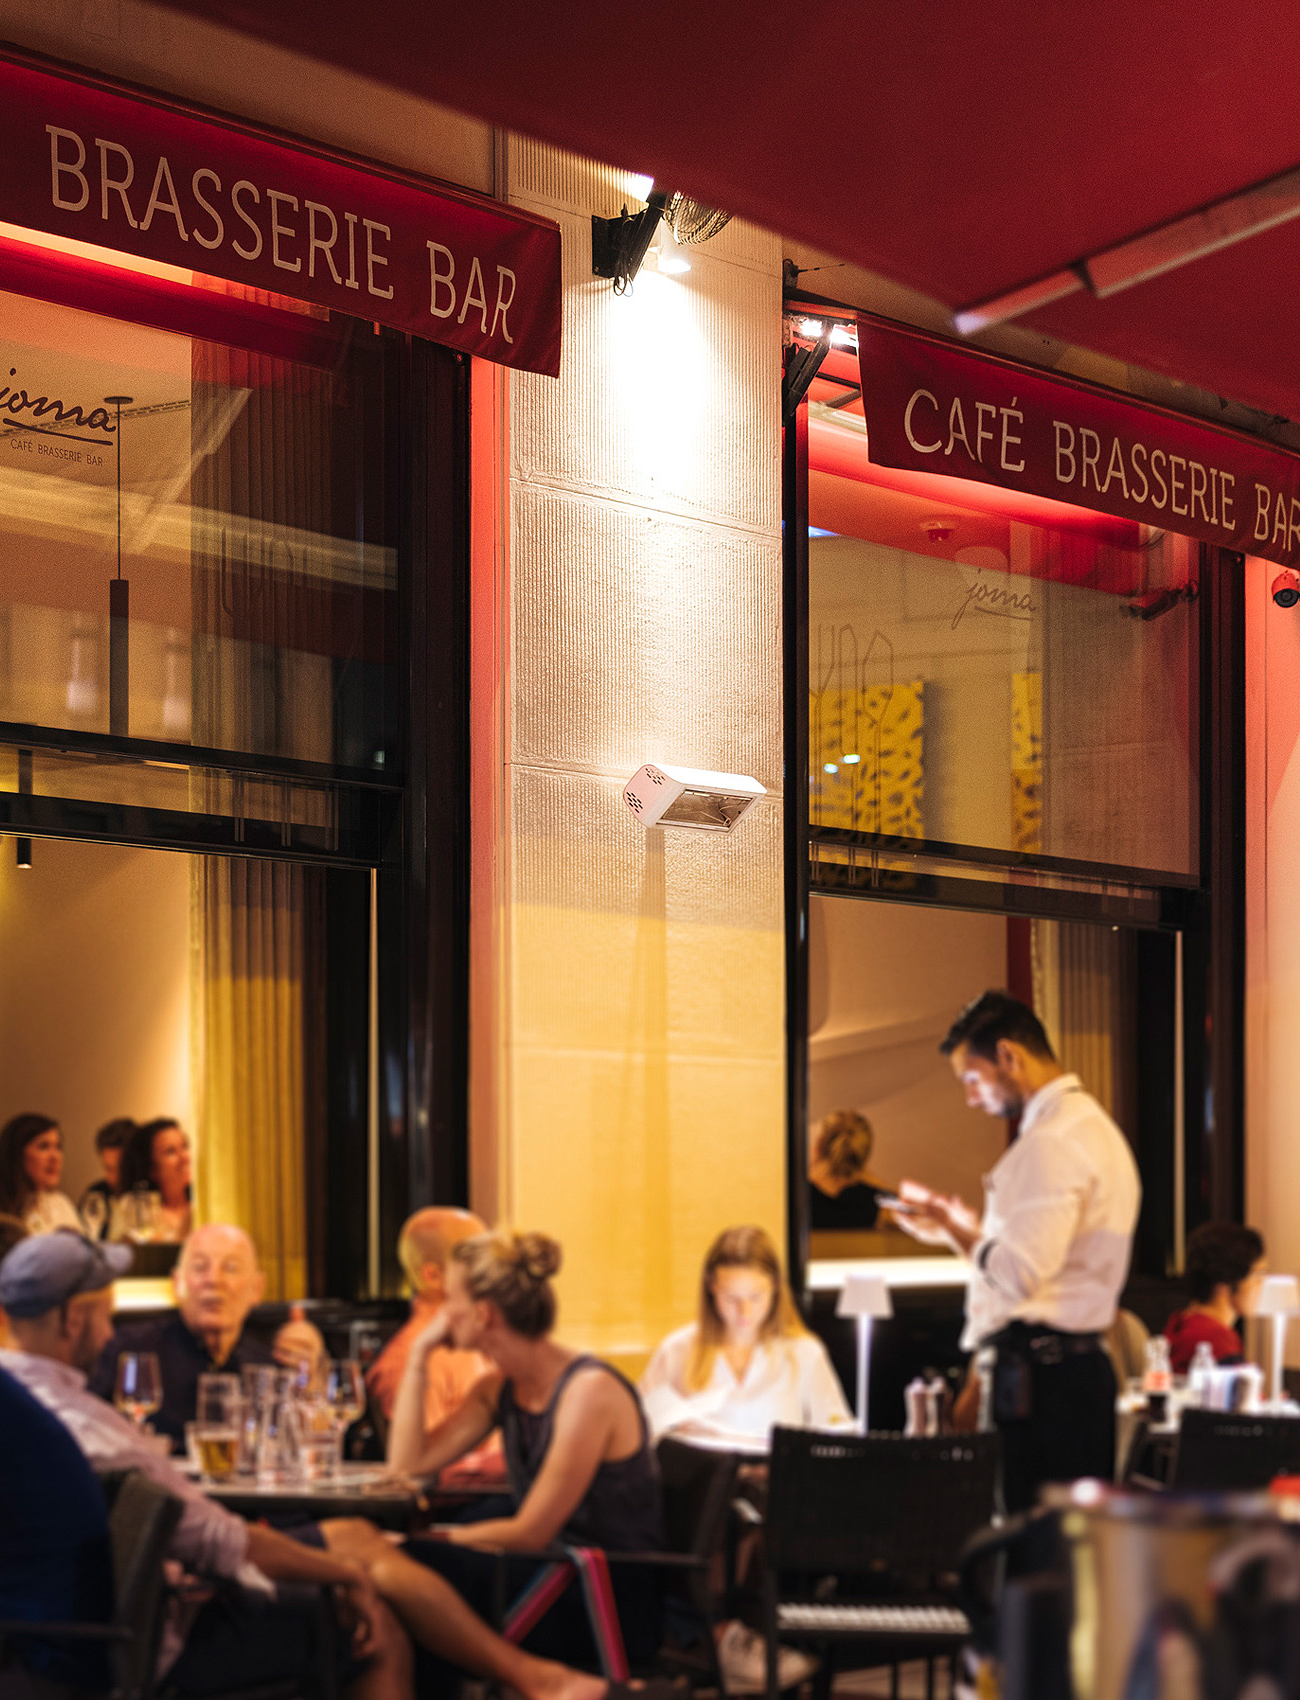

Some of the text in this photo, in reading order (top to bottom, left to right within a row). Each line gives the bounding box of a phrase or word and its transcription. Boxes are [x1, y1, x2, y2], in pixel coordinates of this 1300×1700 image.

[45, 124, 395, 300] BRASSERIE
[426, 240, 516, 345] BAR
[10, 438, 104, 466] CAFÉ BRASSERIE BAR
[903, 388, 1300, 552] CAFÉ BRASSERIE BAR
[950, 567, 1038, 631] joma
